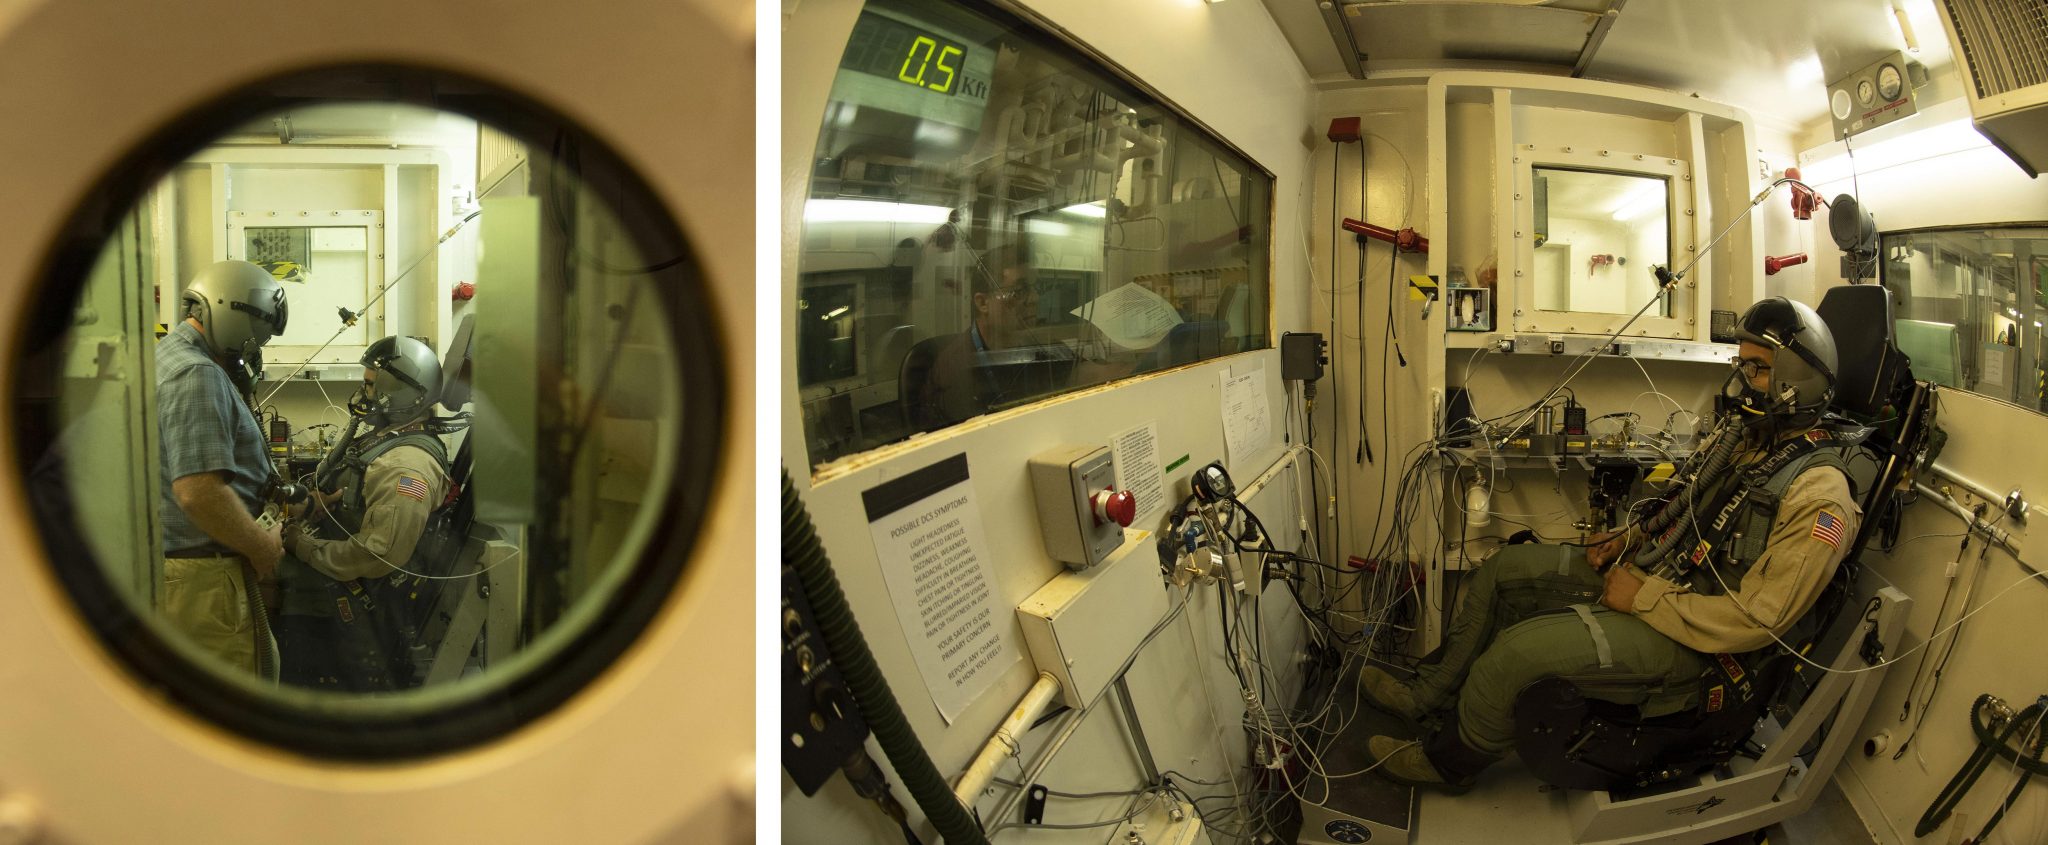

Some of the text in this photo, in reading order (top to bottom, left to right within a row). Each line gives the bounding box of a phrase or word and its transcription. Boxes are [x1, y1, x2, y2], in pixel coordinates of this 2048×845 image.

[898, 35, 988, 100] 0.5 Kft
[891, 495, 968, 539] POSSIBLE DCS SYMPTOMS
[910, 518, 960, 549] LIGHT HEADEDNESS
[910, 527, 965, 561] UNEXPECTED FATIGUE
[940, 537, 968, 556] WEAKNESS
[945, 546, 971, 566] COUGHING
[915, 555, 977, 596] DIFFICULTY IN BREATHING
[918, 564, 980, 607] CHEST PAIN OR TIGHTNESS
[921, 573, 983, 618] SKIN ITCHING OR TINGLING
[970, 581, 986, 596] VISION
[926, 627, 939, 638] PAIN
[938, 621, 946, 630] OR
[945, 603, 971, 624] TIGHTNESS
[977, 590, 990, 603] JOINT
[937, 608, 990, 650] YOUR SAFETY IS OUR
[942, 620, 991, 662] PRIMARY CONCERN
[948, 633, 1000, 680] REPORT ANY CHANGE
[955, 678, 963, 687] IN
[962, 666, 976, 682] HOW
[976, 657, 987, 670] YOU
